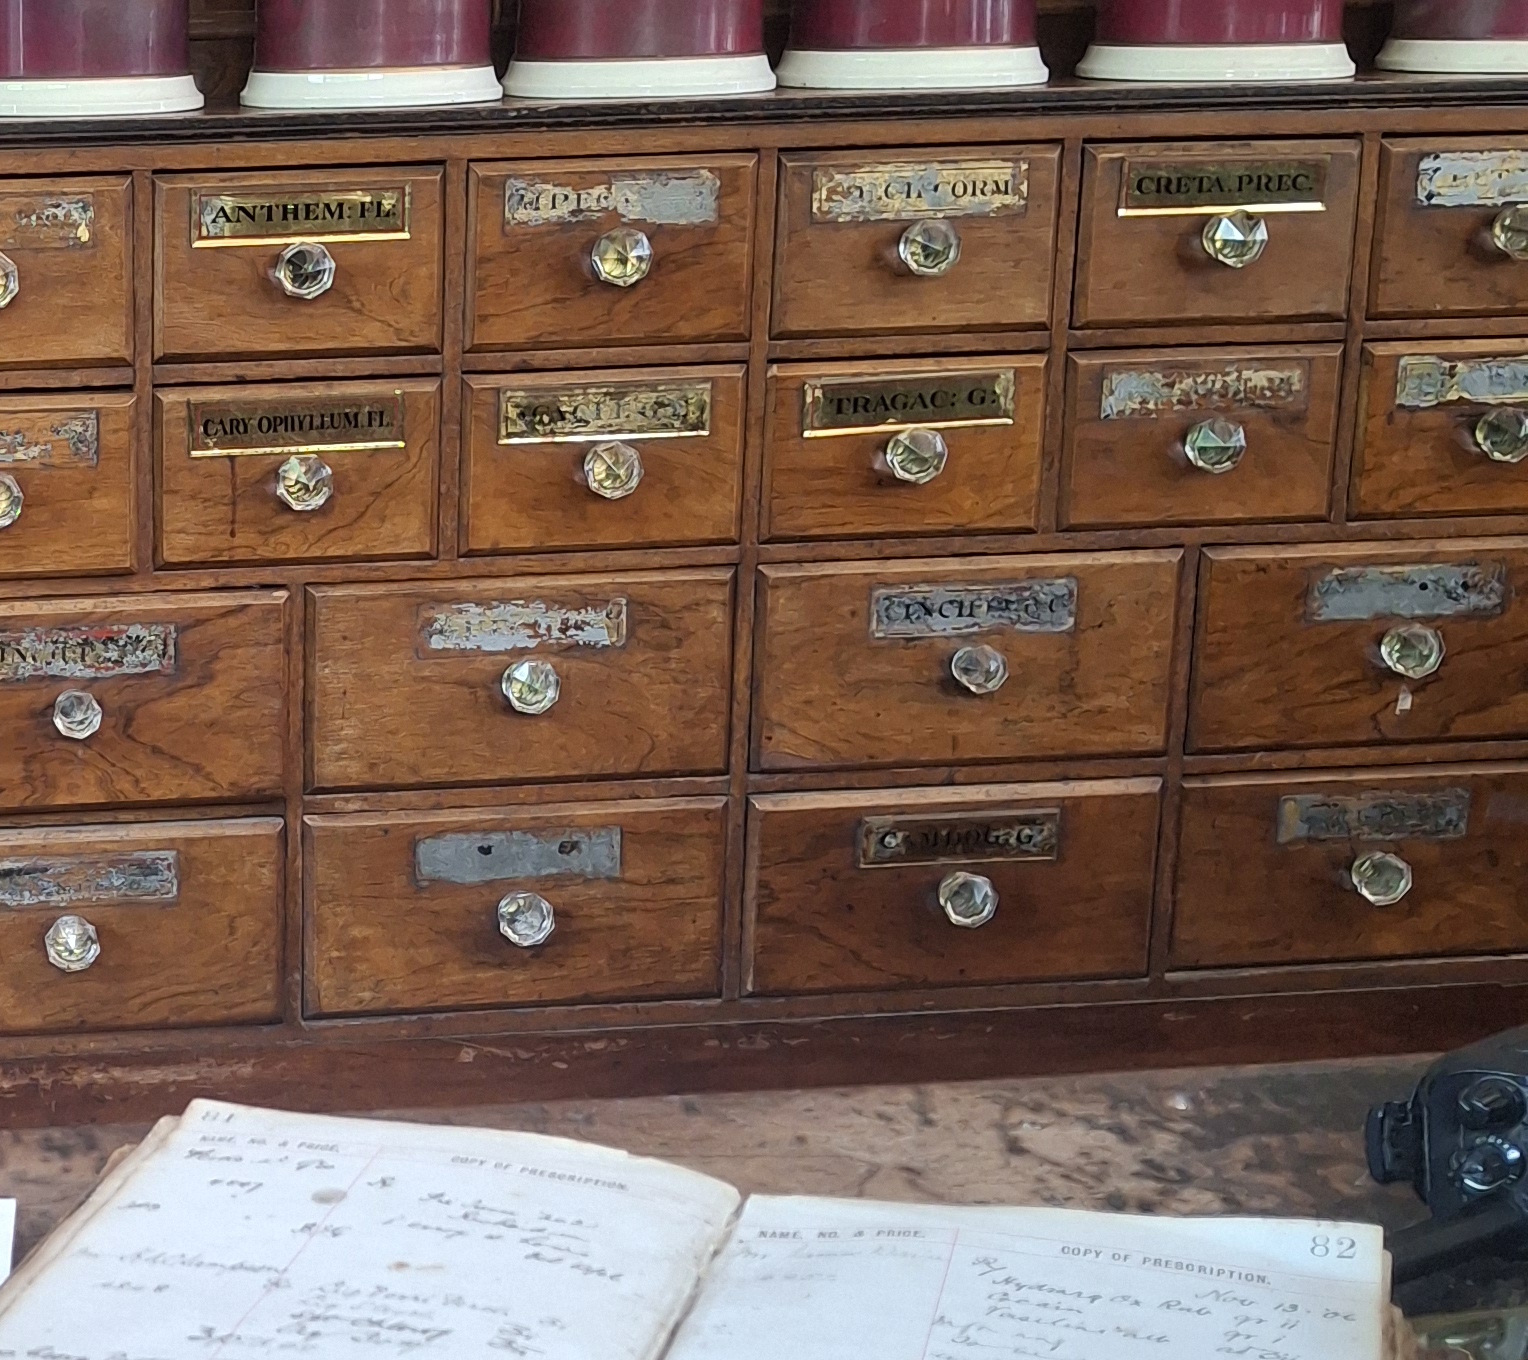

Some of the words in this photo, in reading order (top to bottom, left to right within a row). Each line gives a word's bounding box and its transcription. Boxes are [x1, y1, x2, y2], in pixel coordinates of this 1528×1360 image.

[210, 201, 353, 225] ANTHEM:
[450, 1153, 488, 1169] COPY
[493, 1161, 513, 1171] OF
[1308, 1234, 1358, 1261] 82
[1060, 1245, 1104, 1260] COPY
[1111, 1252, 1131, 1263] OF
[1141, 1256, 1273, 1287] PRESCRIPTION.
